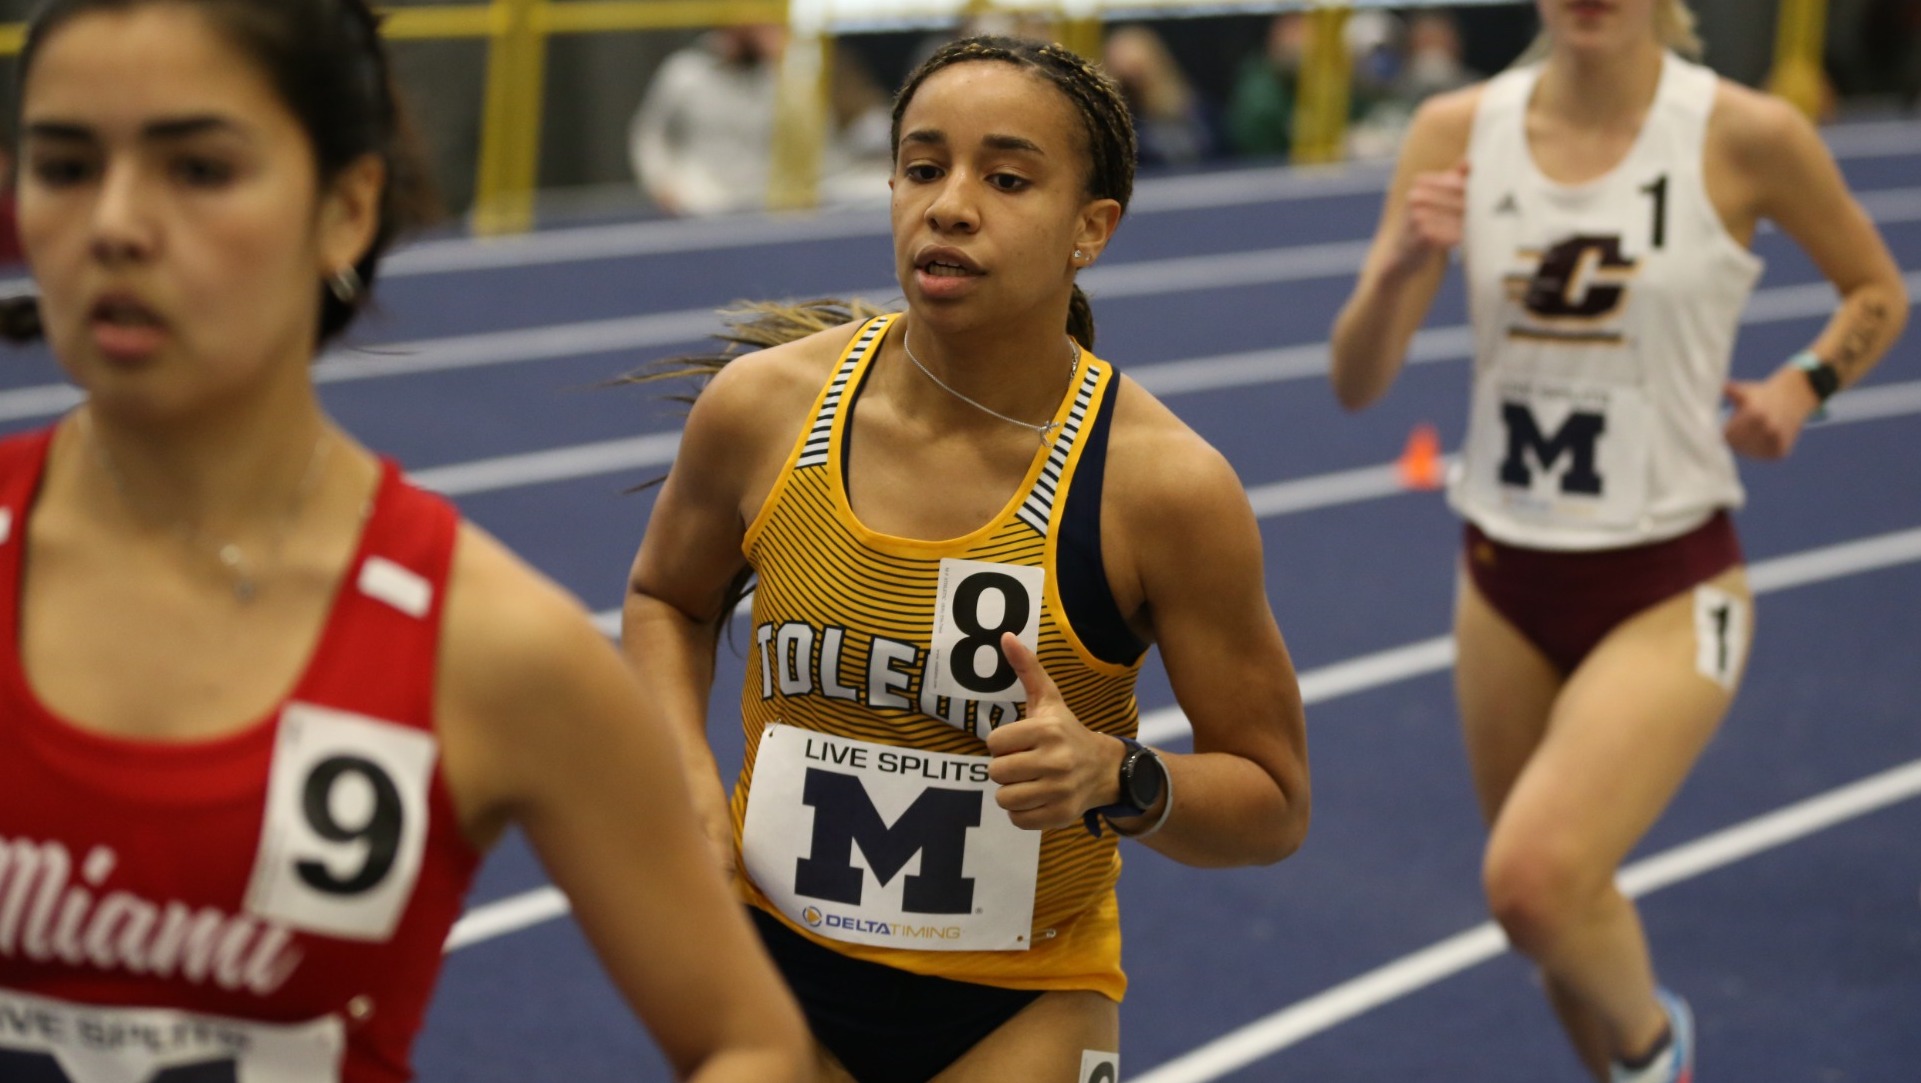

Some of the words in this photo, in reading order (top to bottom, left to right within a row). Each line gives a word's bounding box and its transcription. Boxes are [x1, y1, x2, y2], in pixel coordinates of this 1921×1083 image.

[1639, 174, 1668, 249] 1
[1522, 232, 1644, 325] C
[1498, 401, 1607, 496] M
[949, 571, 1030, 694] 8
[1707, 604, 1730, 672] 1
[804, 738, 868, 768] LIVE
[877, 751, 990, 782] SPLITS
[293, 754, 404, 896] 9
[795, 766, 983, 914] M
